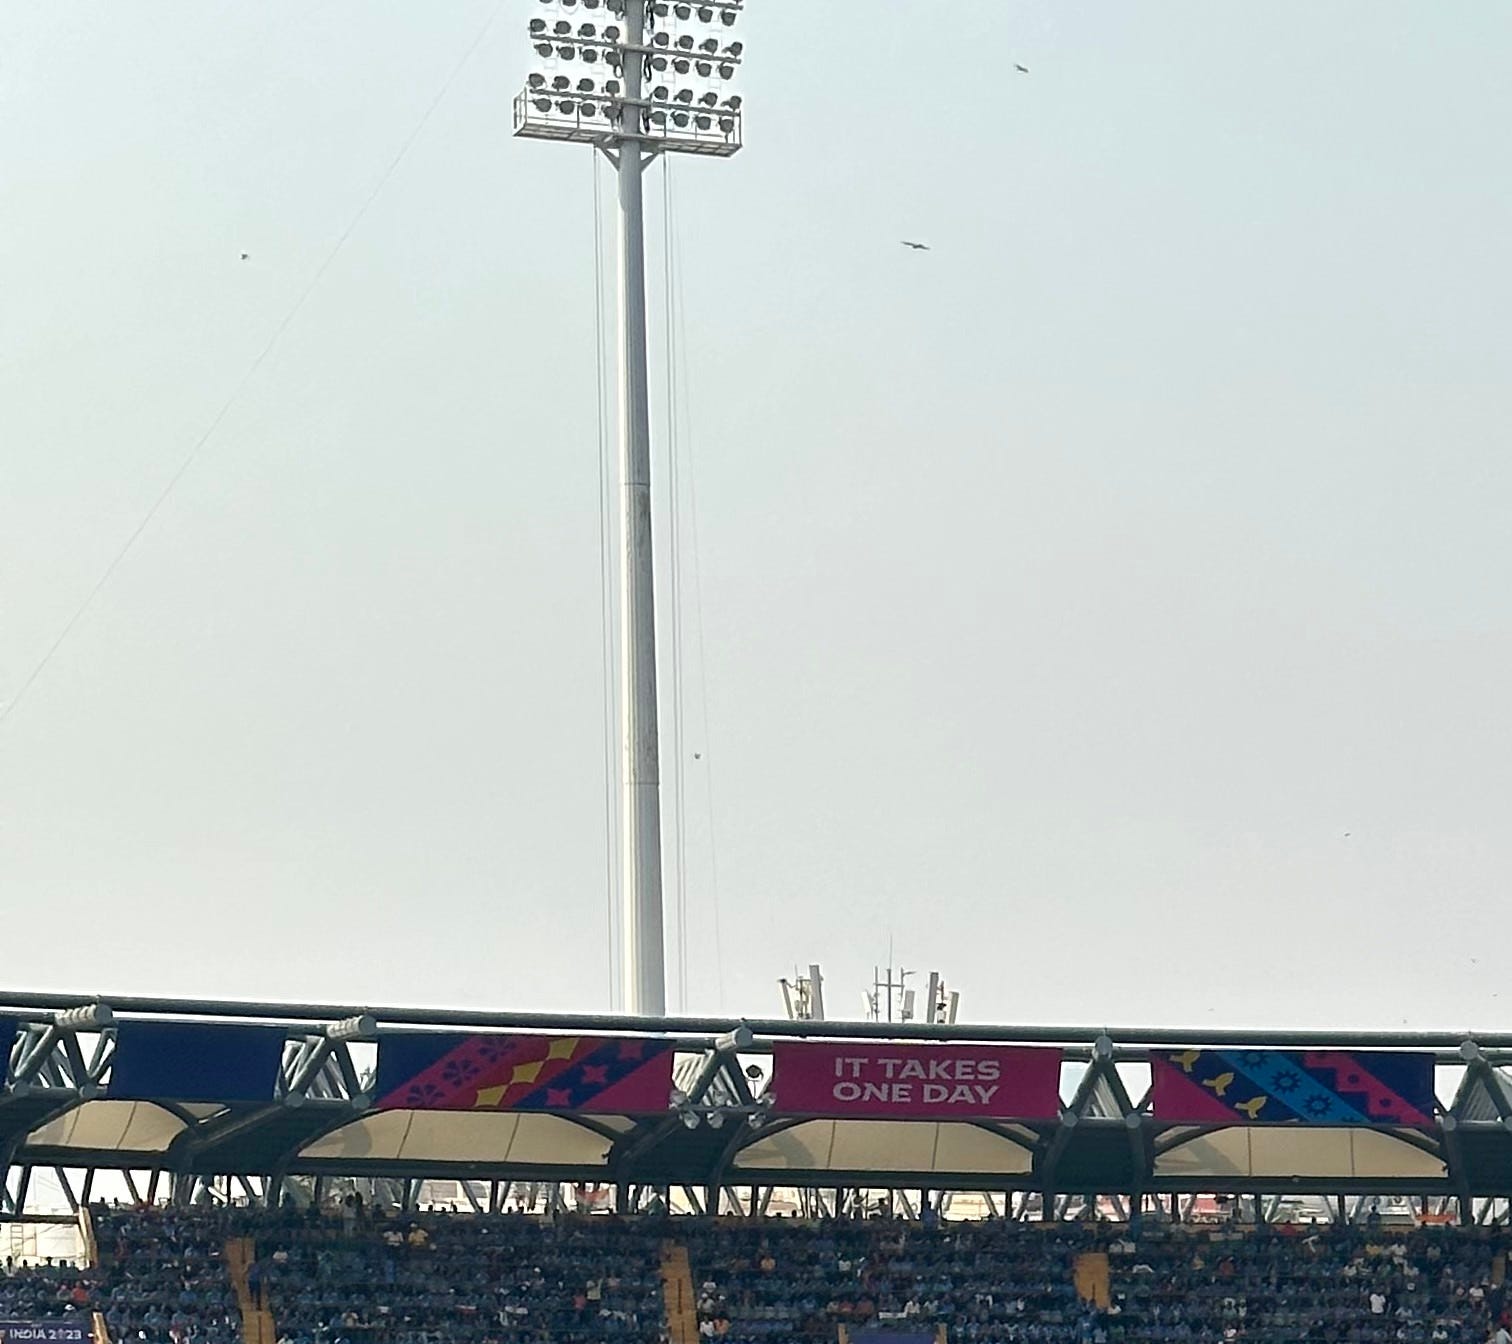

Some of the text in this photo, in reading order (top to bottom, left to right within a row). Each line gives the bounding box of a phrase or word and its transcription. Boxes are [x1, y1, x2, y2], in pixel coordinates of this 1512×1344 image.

[834, 1057, 1001, 1082] IT TAKES
[832, 1081, 1001, 1105] ONE DAY
